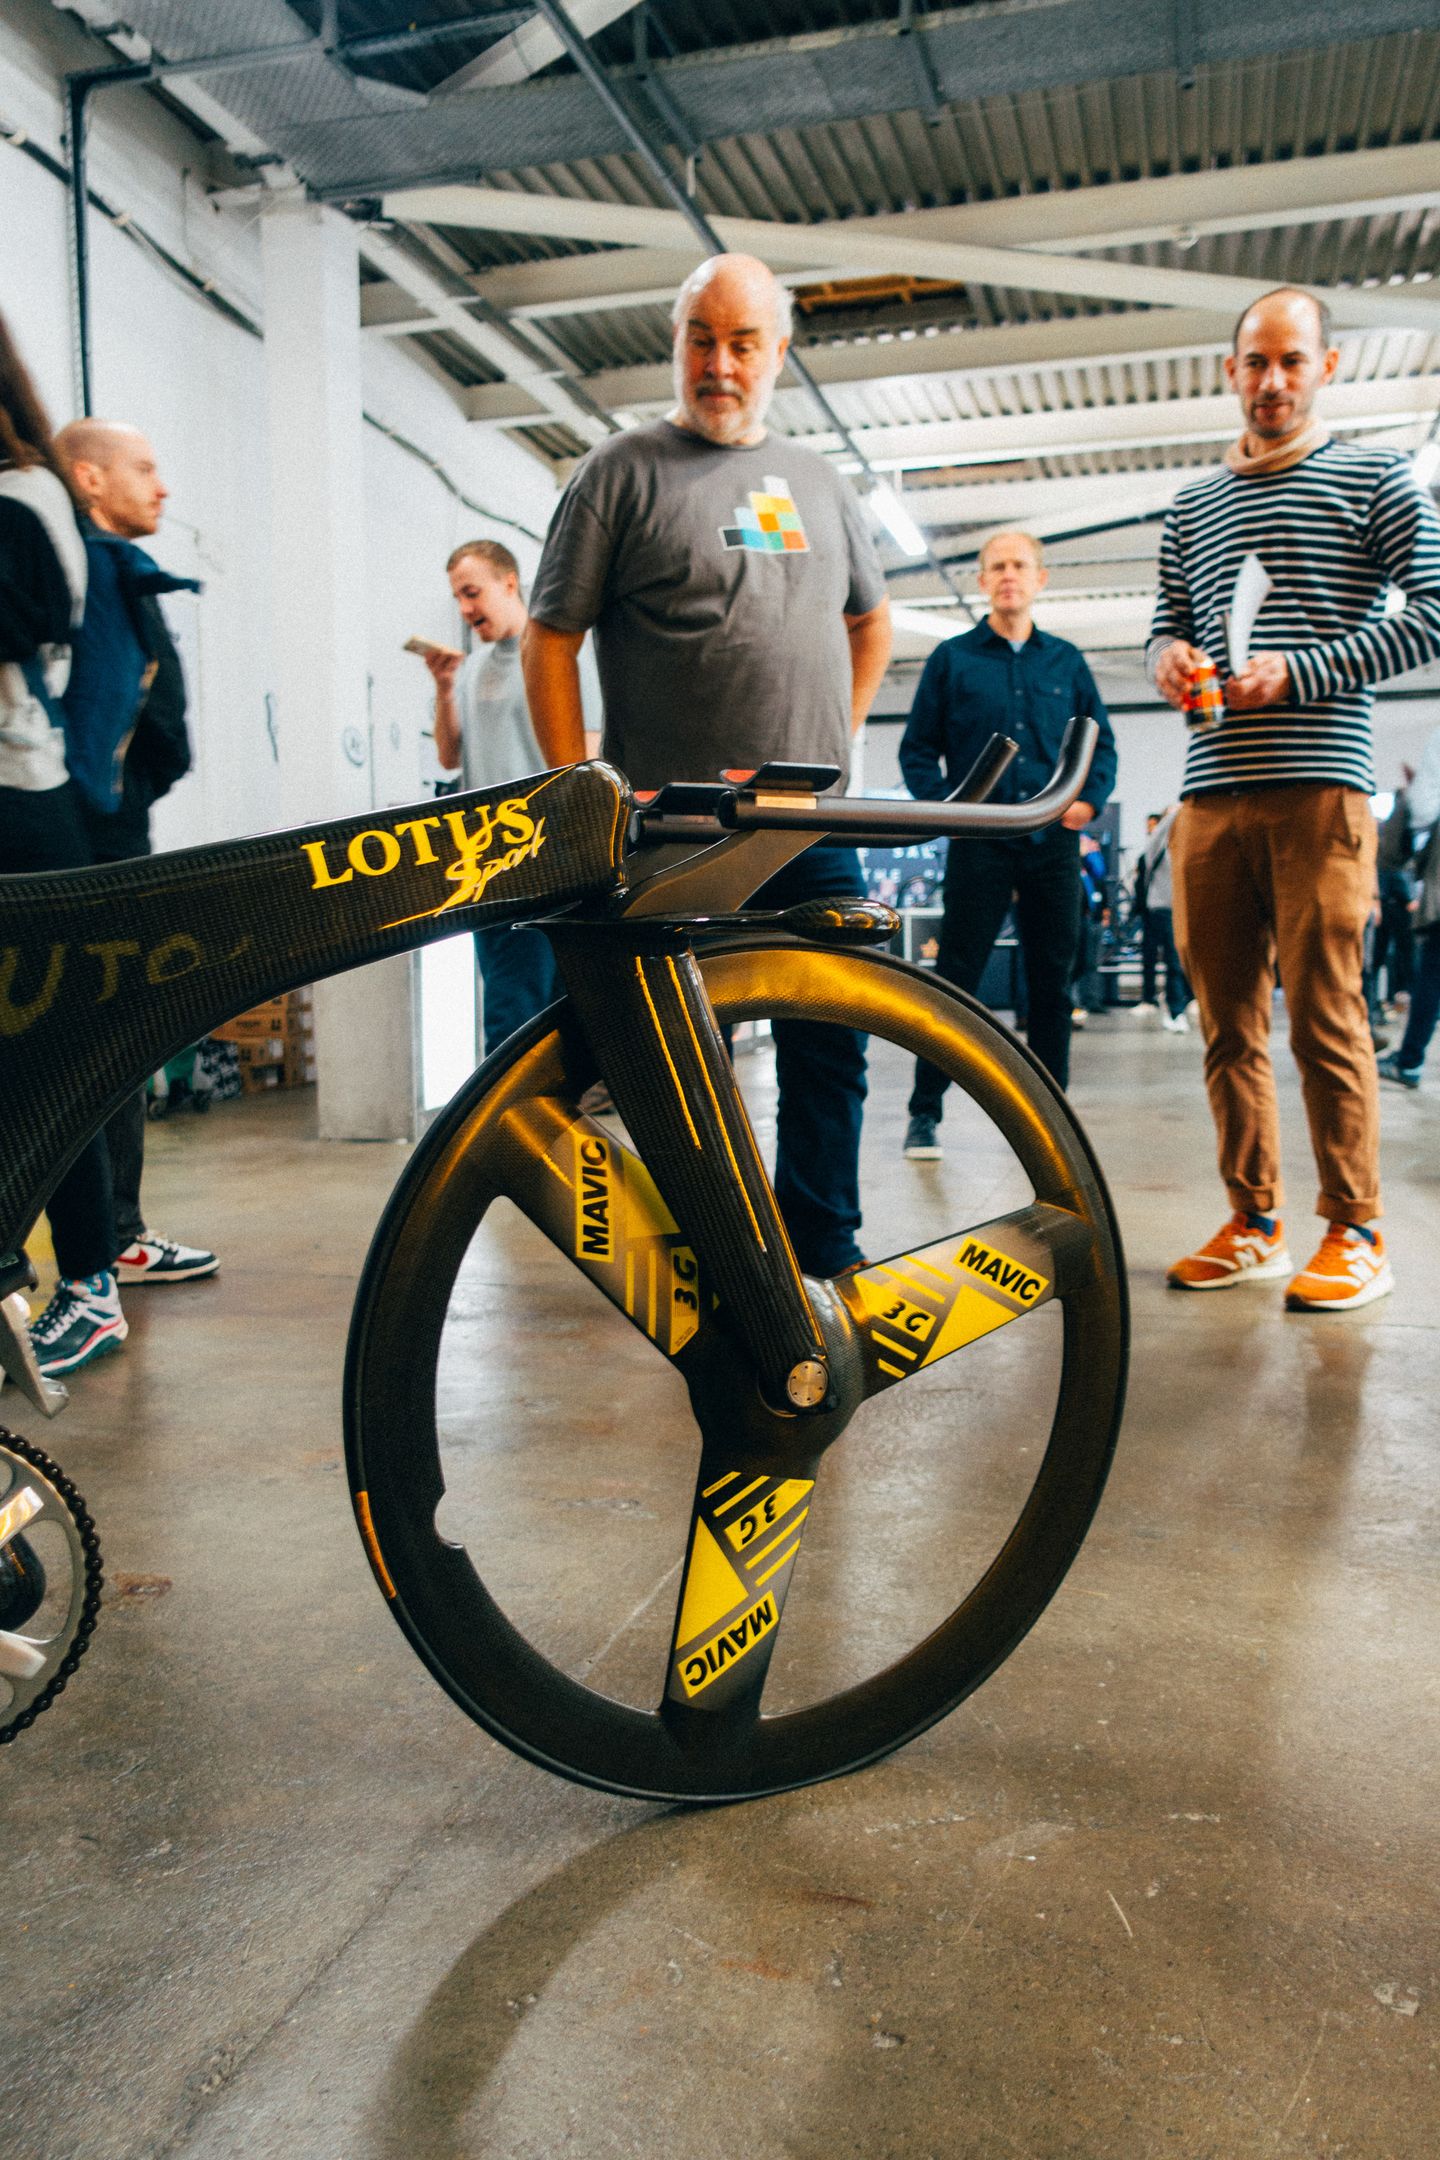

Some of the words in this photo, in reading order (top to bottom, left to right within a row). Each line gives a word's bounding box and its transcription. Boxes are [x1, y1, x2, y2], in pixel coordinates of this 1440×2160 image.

[301, 798, 535, 890] LOTUS
[433, 816, 546, 918] Sport
[580, 1137, 610, 1256] MAVIC
[673, 1254, 699, 1311] 3G
[959, 1243, 1041, 1301] MAVIC
[881, 1300, 930, 1333] 3G
[740, 1492, 777, 1545] 3G
[685, 1599, 773, 1687] MAVIC
